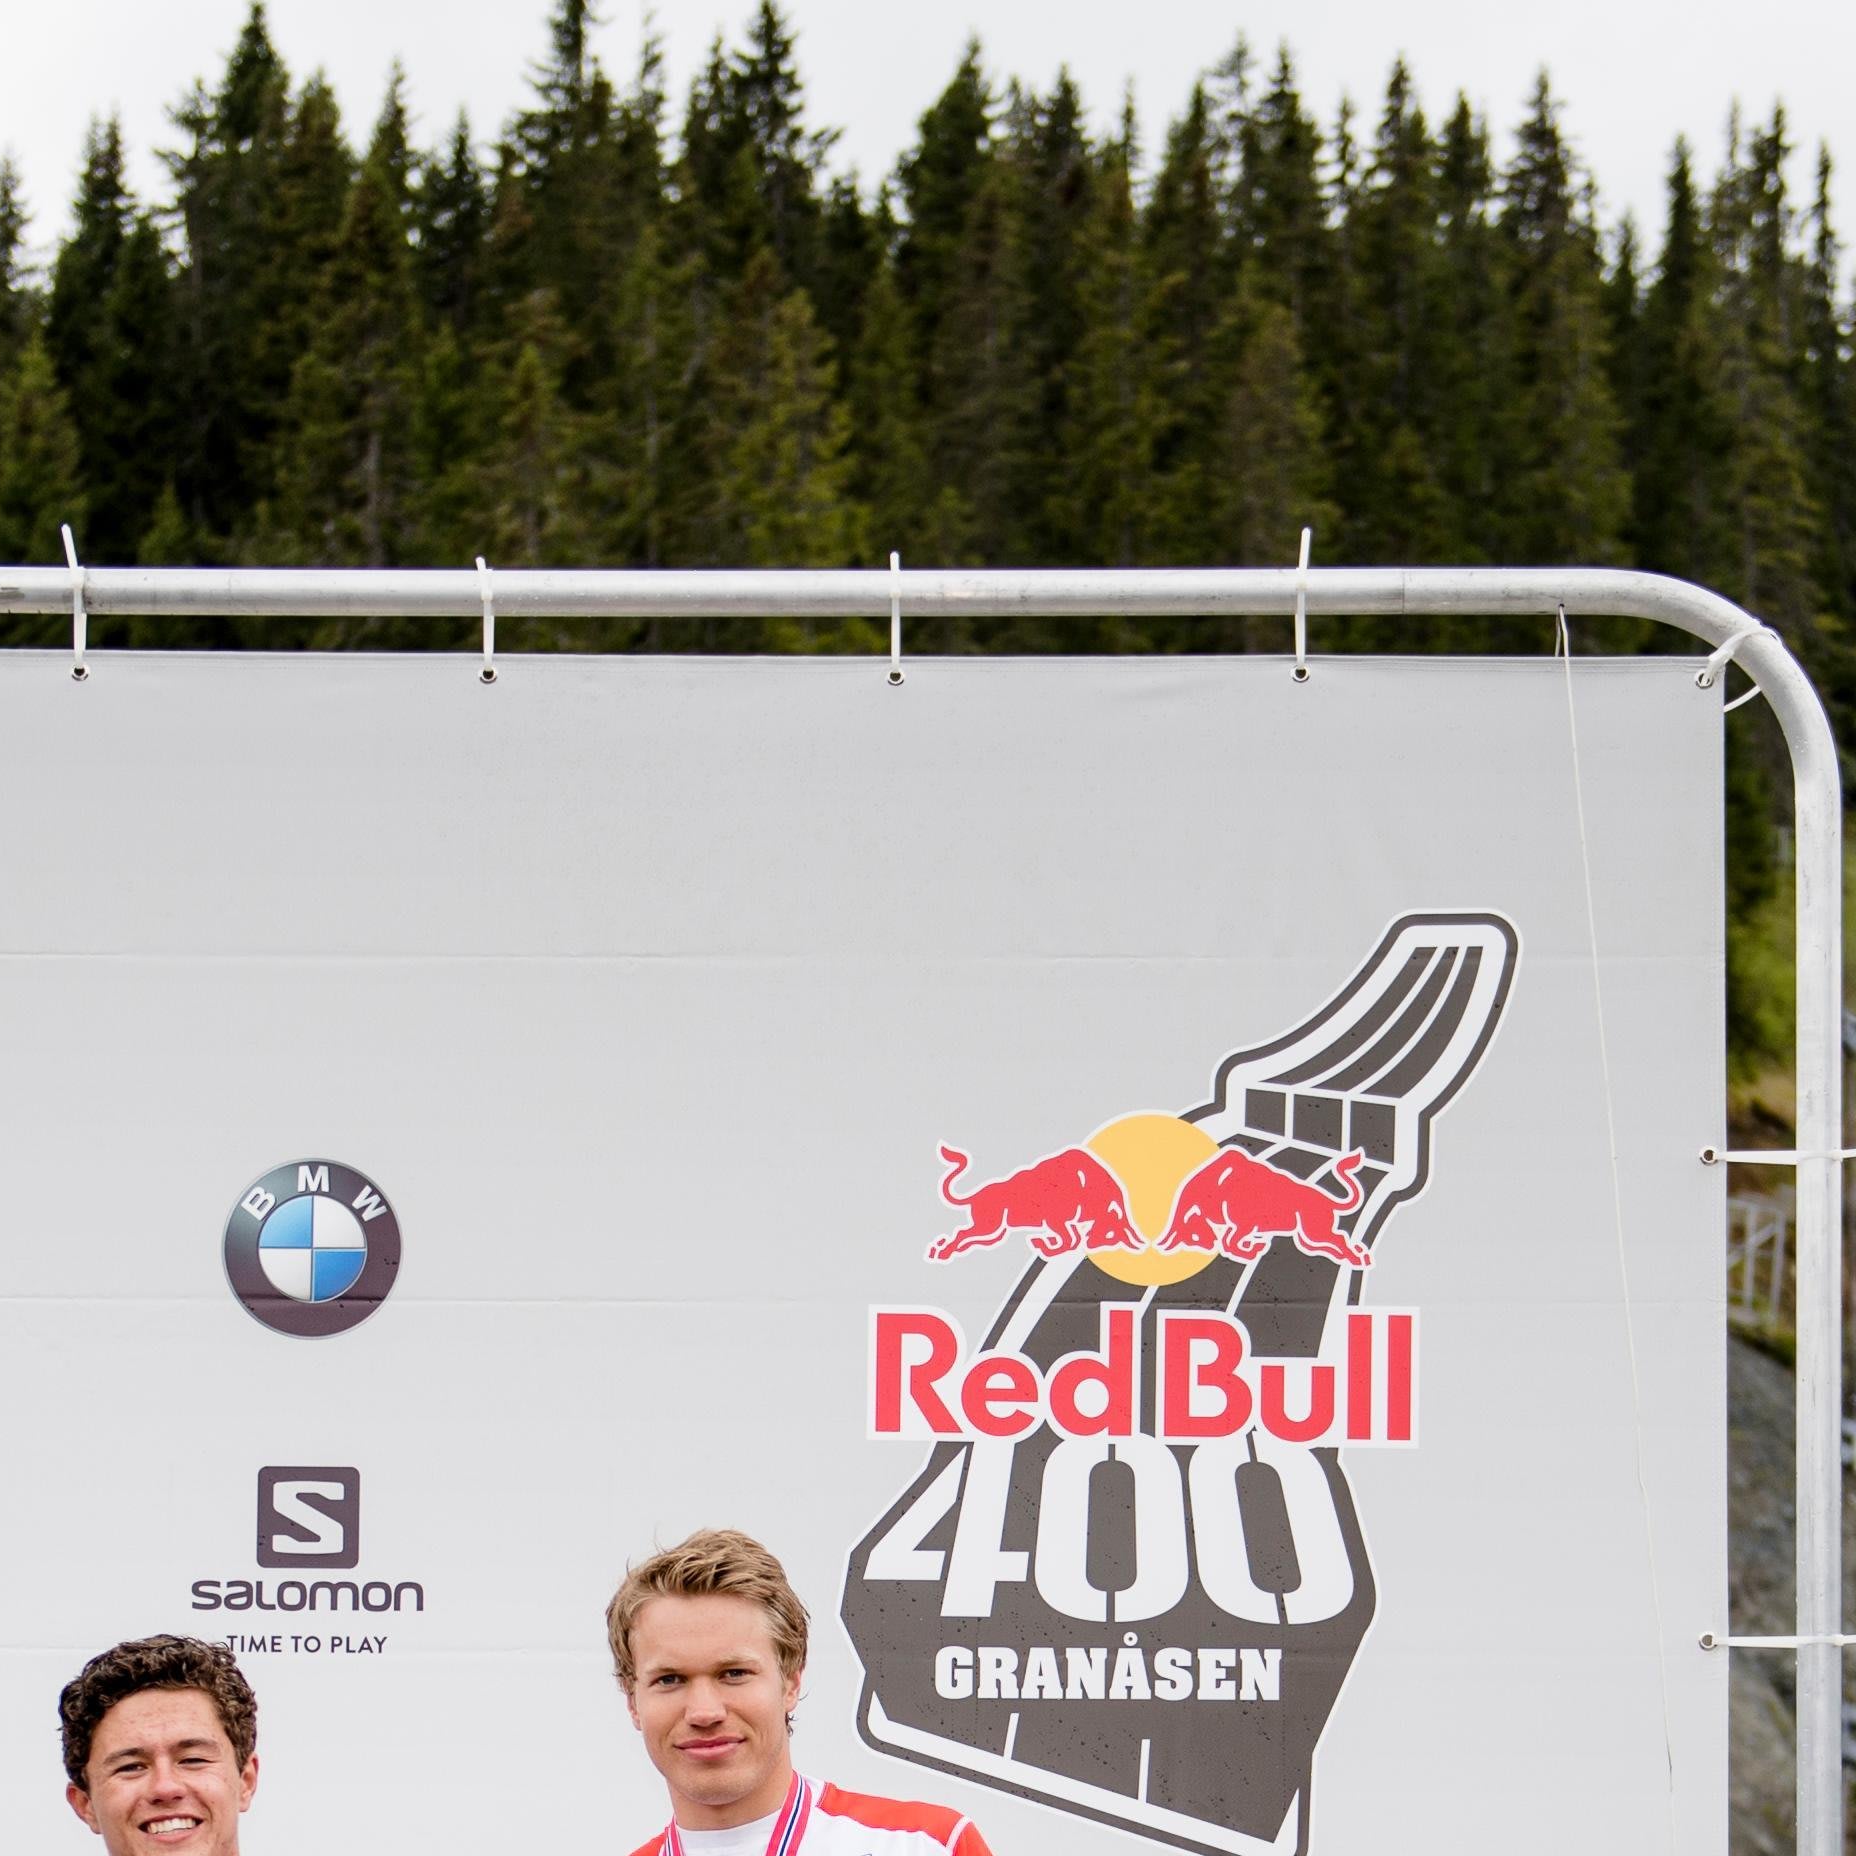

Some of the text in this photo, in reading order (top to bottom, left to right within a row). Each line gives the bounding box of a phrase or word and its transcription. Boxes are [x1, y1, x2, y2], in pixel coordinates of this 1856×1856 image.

[241, 1165, 388, 1222] BMW
[875, 1309, 1412, 1442] Red Bull
[863, 1433, 1355, 1625] 400
[227, 1636, 387, 1653] TIME TO PLAY
[933, 1631, 1282, 1702] GRANÅSEN
